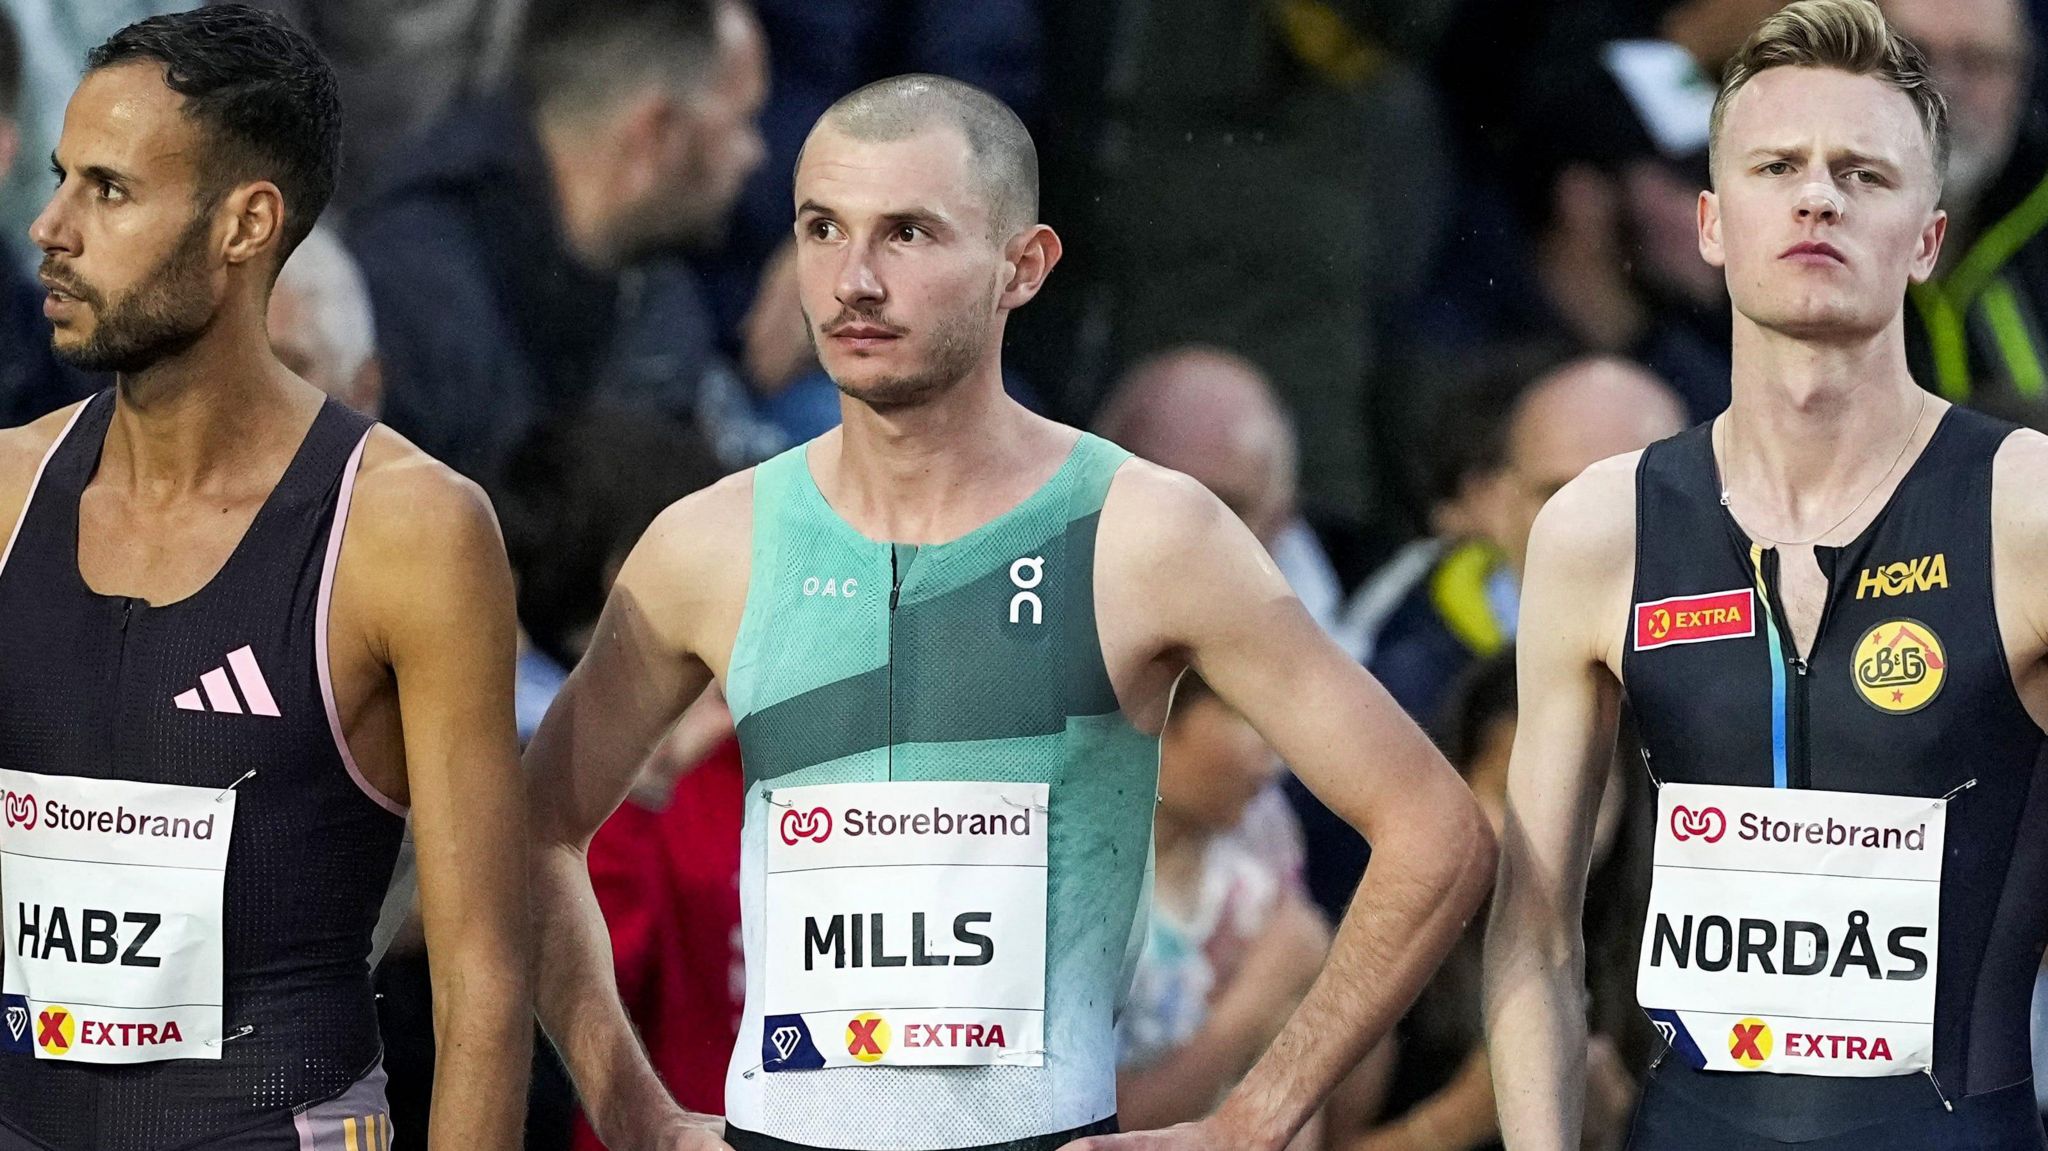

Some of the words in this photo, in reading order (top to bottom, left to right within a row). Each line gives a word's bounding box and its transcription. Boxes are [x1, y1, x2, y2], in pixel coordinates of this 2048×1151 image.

[803, 576, 858, 598] OAC
[1856, 553, 1949, 600] HOKA
[1675, 606, 1741, 628] EXTRA
[44, 800, 214, 839] Storebrand
[843, 807, 1030, 837] Storebrand
[1738, 812, 1925, 850] Storebrand
[18, 901, 162, 968] HABZ
[804, 911, 995, 971] MILLS
[1650, 910, 1928, 981] NORDÅS
[81, 1020, 182, 1046] EXTRA
[903, 1023, 1006, 1048] EXTRA
[1785, 1032, 1893, 1061] EXTRA
